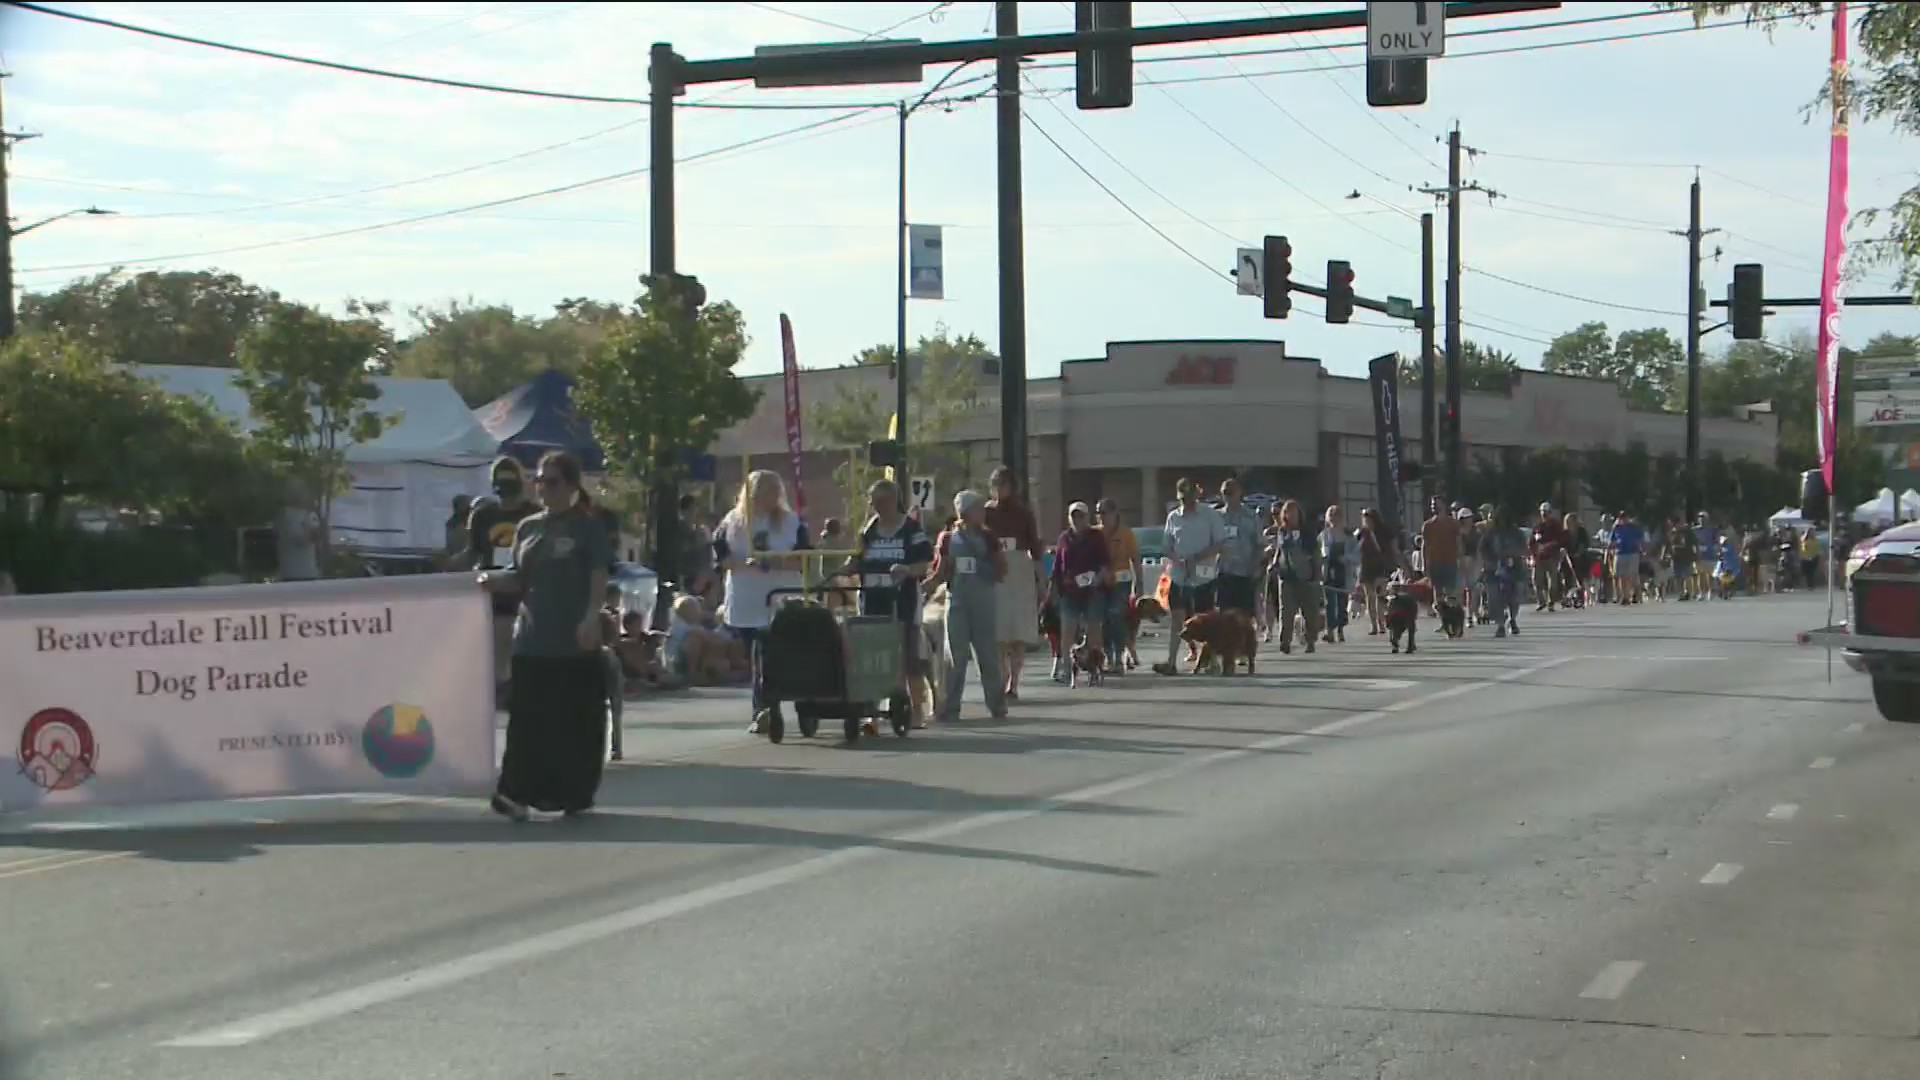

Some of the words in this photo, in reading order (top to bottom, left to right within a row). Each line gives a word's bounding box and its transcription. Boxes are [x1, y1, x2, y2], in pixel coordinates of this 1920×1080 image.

[1380, 31, 1432, 49] ONLY
[1165, 355, 1238, 385] ACE
[1869, 407, 1904, 422] ACE
[36, 618, 204, 652] Beaverdale
[214, 614, 268, 642] Fall
[279, 607, 393, 639] Festival
[136, 669, 198, 701] Dog
[207, 661, 308, 691] Parade
[218, 732, 321, 751] PRESENTED
